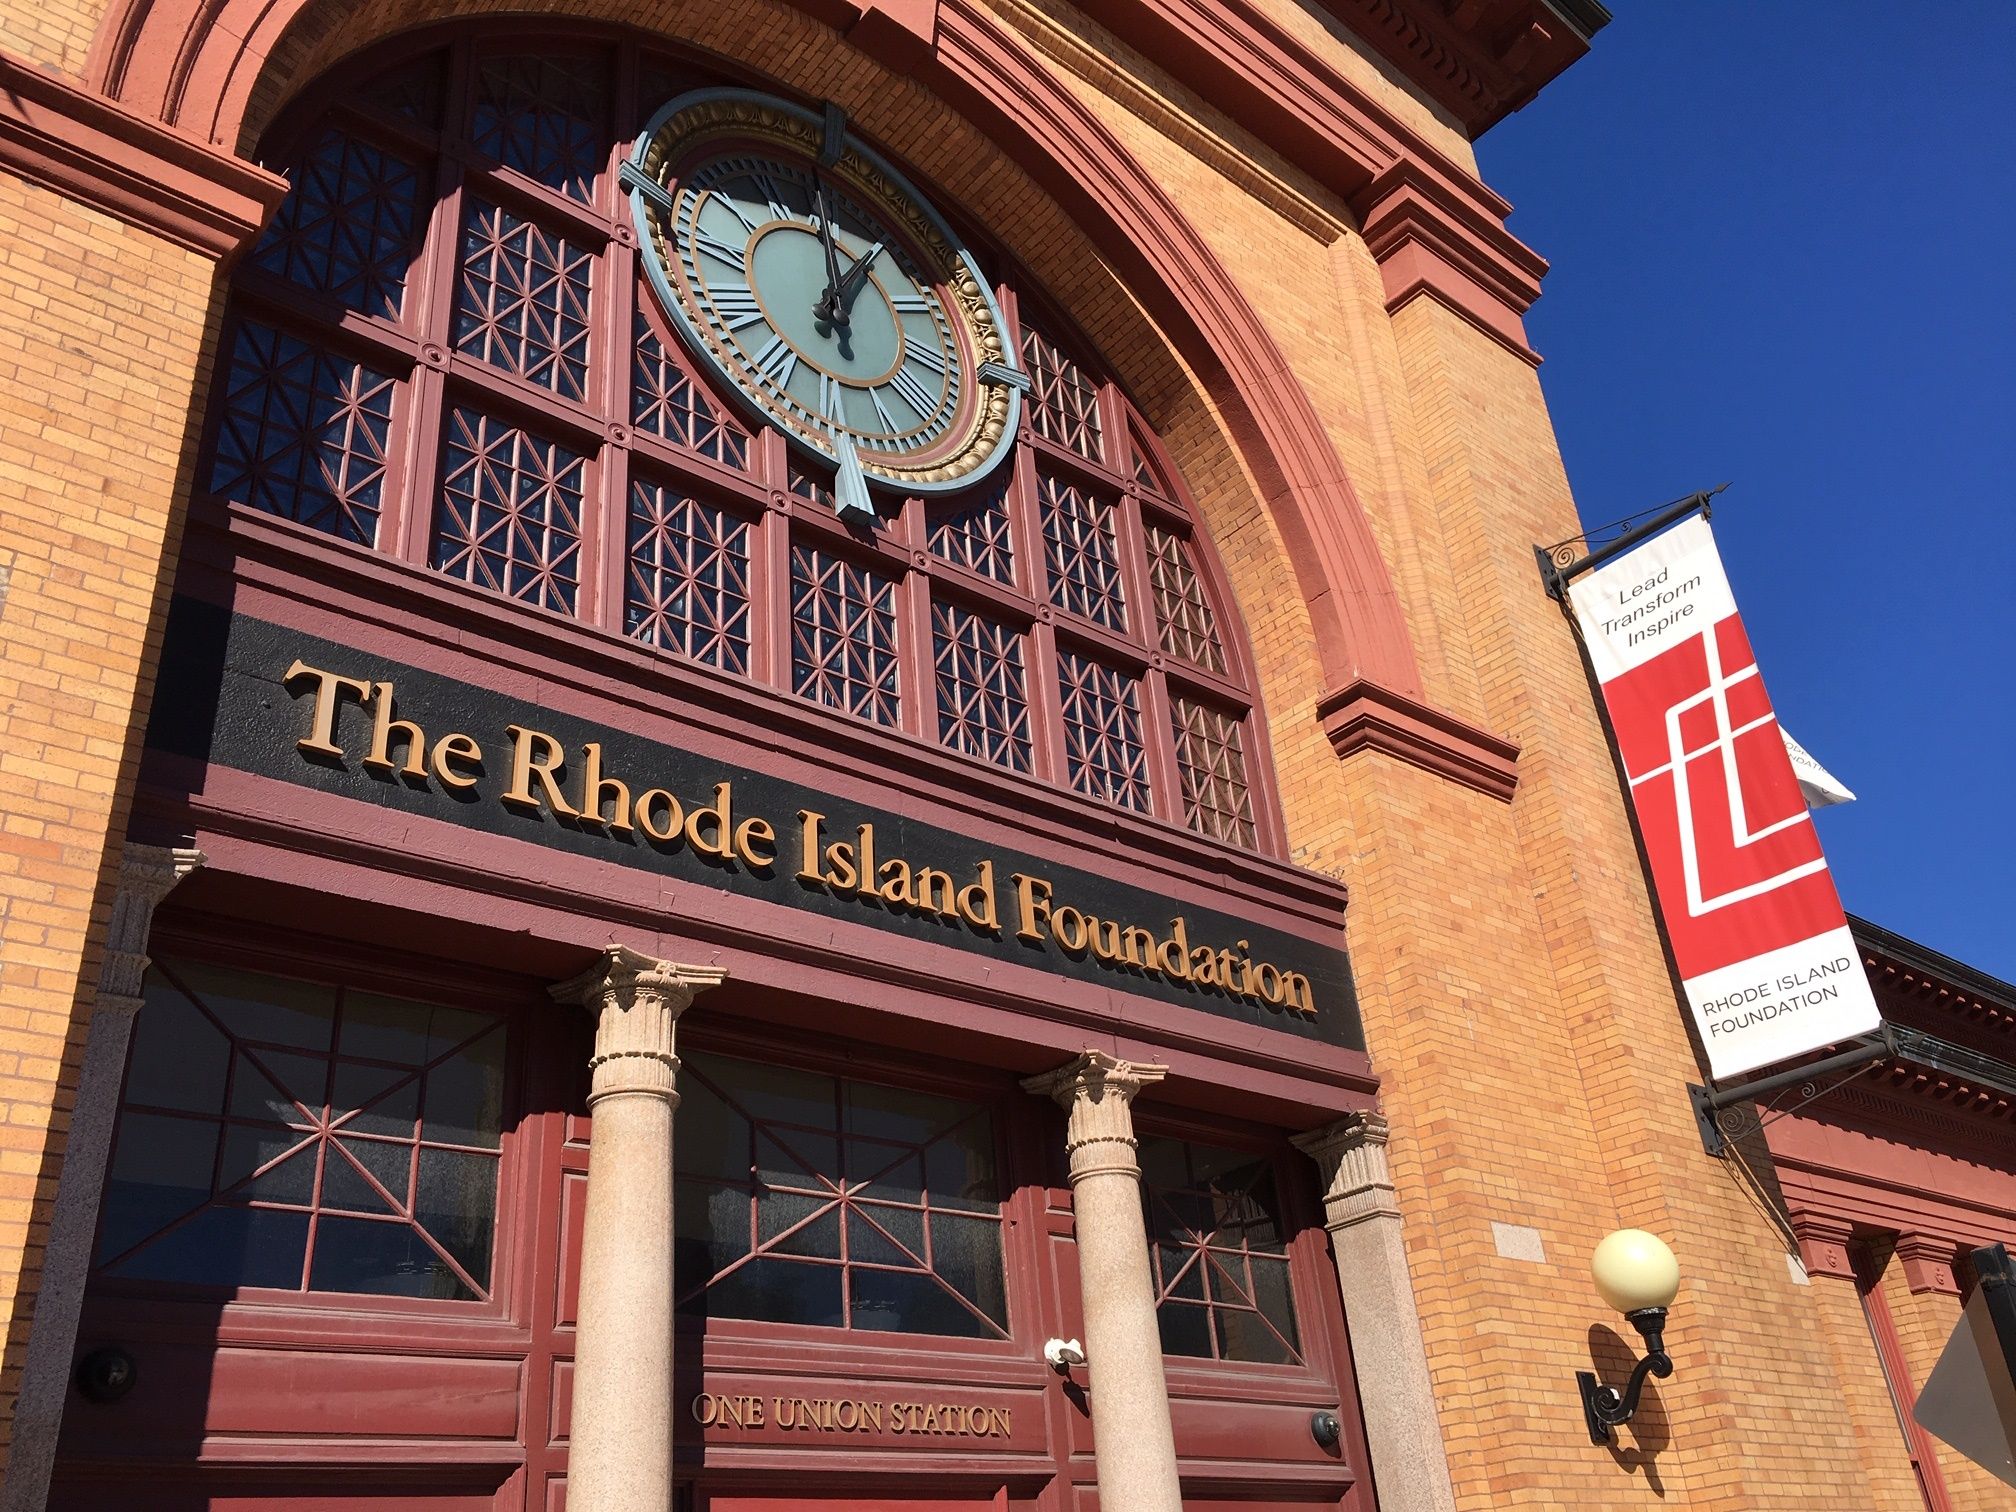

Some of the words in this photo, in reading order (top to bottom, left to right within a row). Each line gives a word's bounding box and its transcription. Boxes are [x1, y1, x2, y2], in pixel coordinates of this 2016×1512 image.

[1601, 575, 1701, 635] Transform
[1619, 567, 1669, 605] Lead
[1628, 603, 1694, 647] Inspire
[282, 659, 482, 789] The
[500, 725, 775, 867] Rhode
[796, 809, 1002, 931] Island
[1011, 872, 1318, 1014] Foundation
[1702, 983, 1771, 1016] RHODE
[1776, 957, 1851, 992] ISLAND
[1710, 985, 1838, 1038] FOUNDATION
[692, 1393, 765, 1426] ONE
[773, 1397, 882, 1431] UNION
[890, 1402, 1012, 1436] STATION
